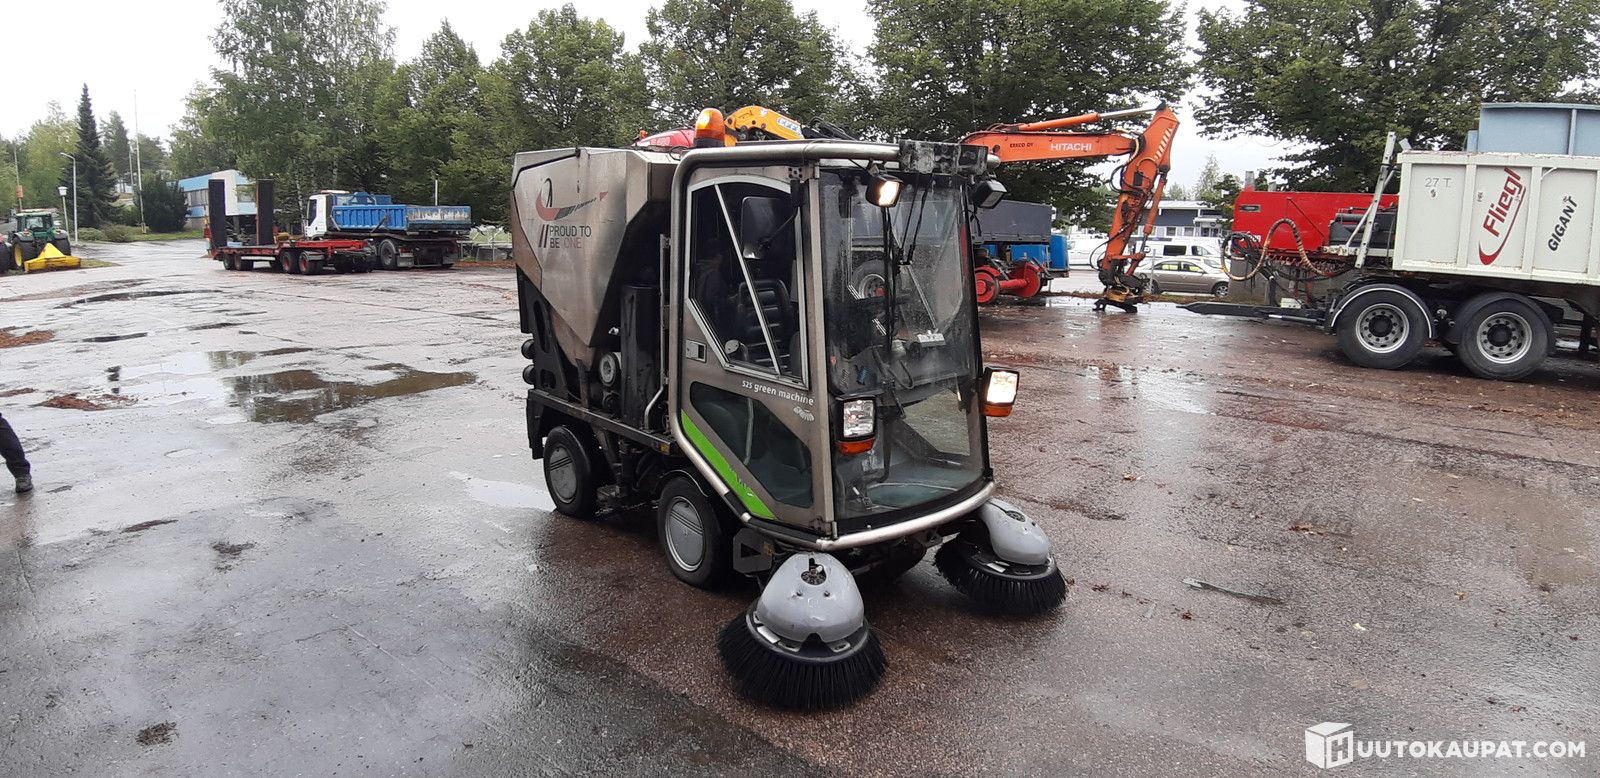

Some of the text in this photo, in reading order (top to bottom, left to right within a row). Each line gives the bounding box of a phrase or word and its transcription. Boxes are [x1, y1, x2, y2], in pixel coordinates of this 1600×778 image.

[1050, 142, 1093, 152] HITACHI
[1425, 177, 1452, 188] 27 T
[1482, 166, 1523, 237] Fliegl
[1547, 195, 1578, 252] GIGANT
[549, 225, 592, 238] PROUD TO
[549, 236, 582, 249] BE ONE
[742, 380, 814, 406] 525 green machine
